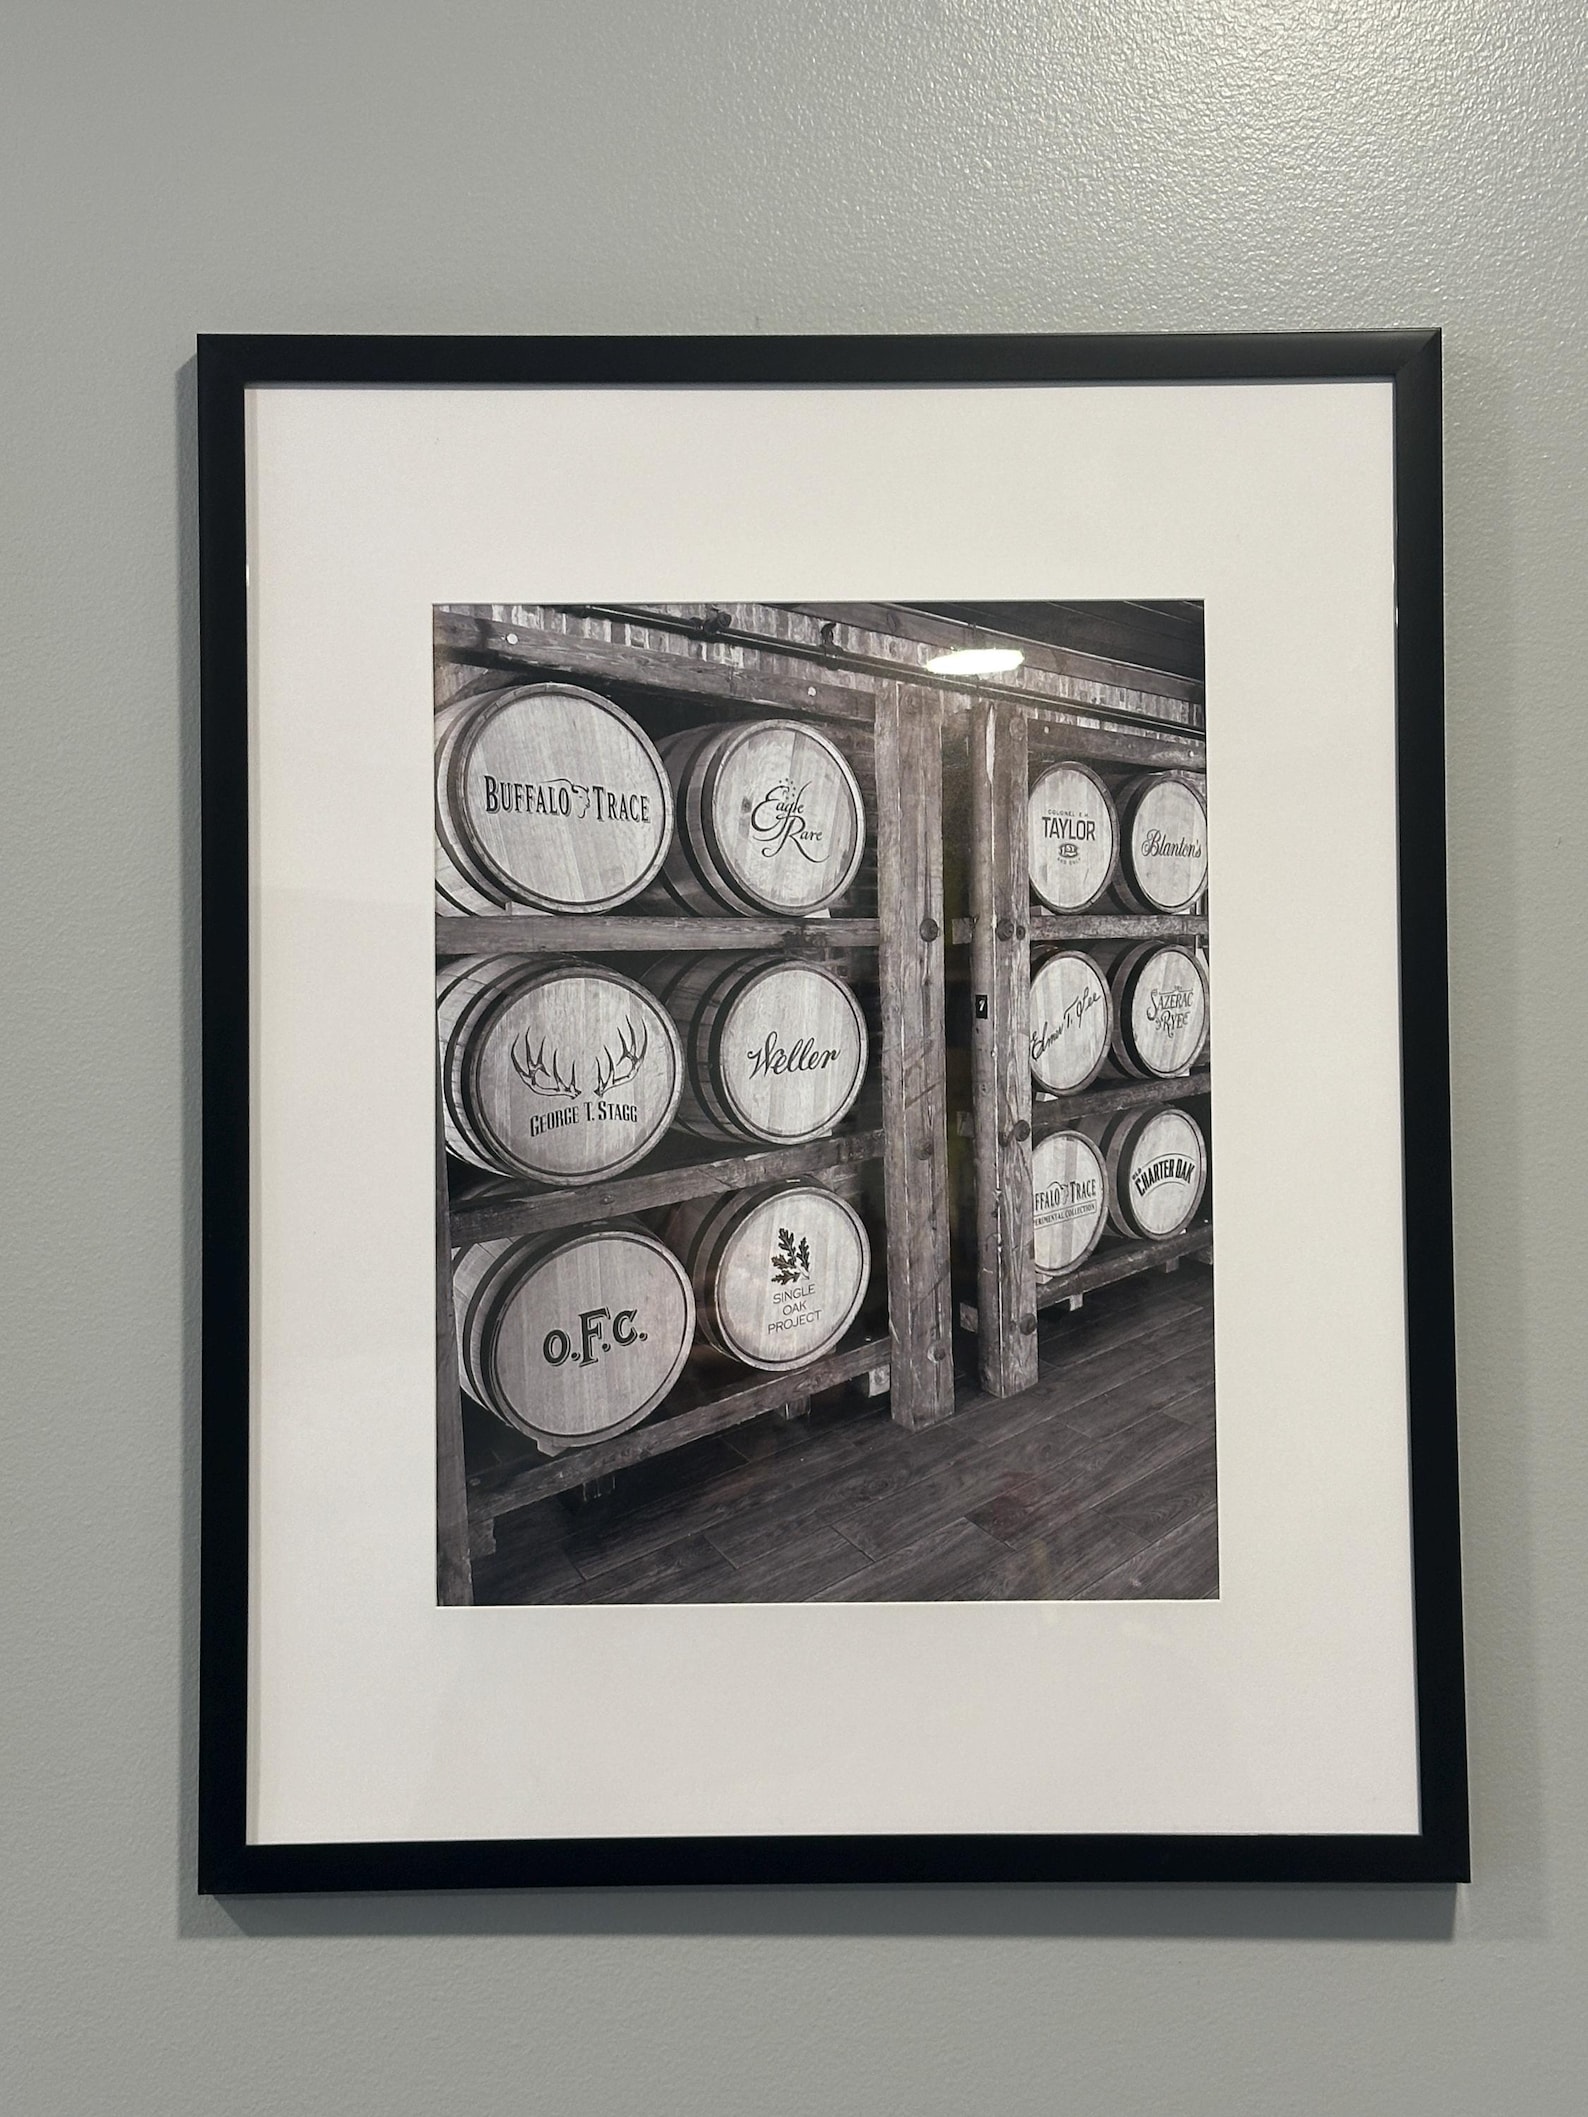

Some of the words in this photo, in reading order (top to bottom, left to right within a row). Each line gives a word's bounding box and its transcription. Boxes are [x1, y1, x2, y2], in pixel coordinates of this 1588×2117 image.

[484, 775, 571, 816] BUFFALO
[593, 785, 651, 823] TRACE
[751, 781, 812, 841] Eagle
[761, 815, 830, 863] Rare
[1042, 816, 1096, 841] TAYLOR
[1141, 828, 1202, 858] Blanton's
[1146, 988, 1194, 1021] SAZERAC
[747, 1030, 840, 1080] Weller
[530, 1105, 580, 1137] GEORGE
[583, 1101, 595, 1122] T.
[598, 1100, 637, 1123] STAGG
[1135, 1159, 1175, 1197] CHARTER
[1175, 1158, 1196, 1184] OAK
[1035, 1188, 1060, 1212] FFALO
[1069, 1179, 1096, 1204] TRACE
[773, 1283, 816, 1304] SINGLE
[782, 1300, 807, 1316] OAK
[543, 1306, 648, 1368] O.F.C.
[768, 1309, 822, 1335] PROJECT
